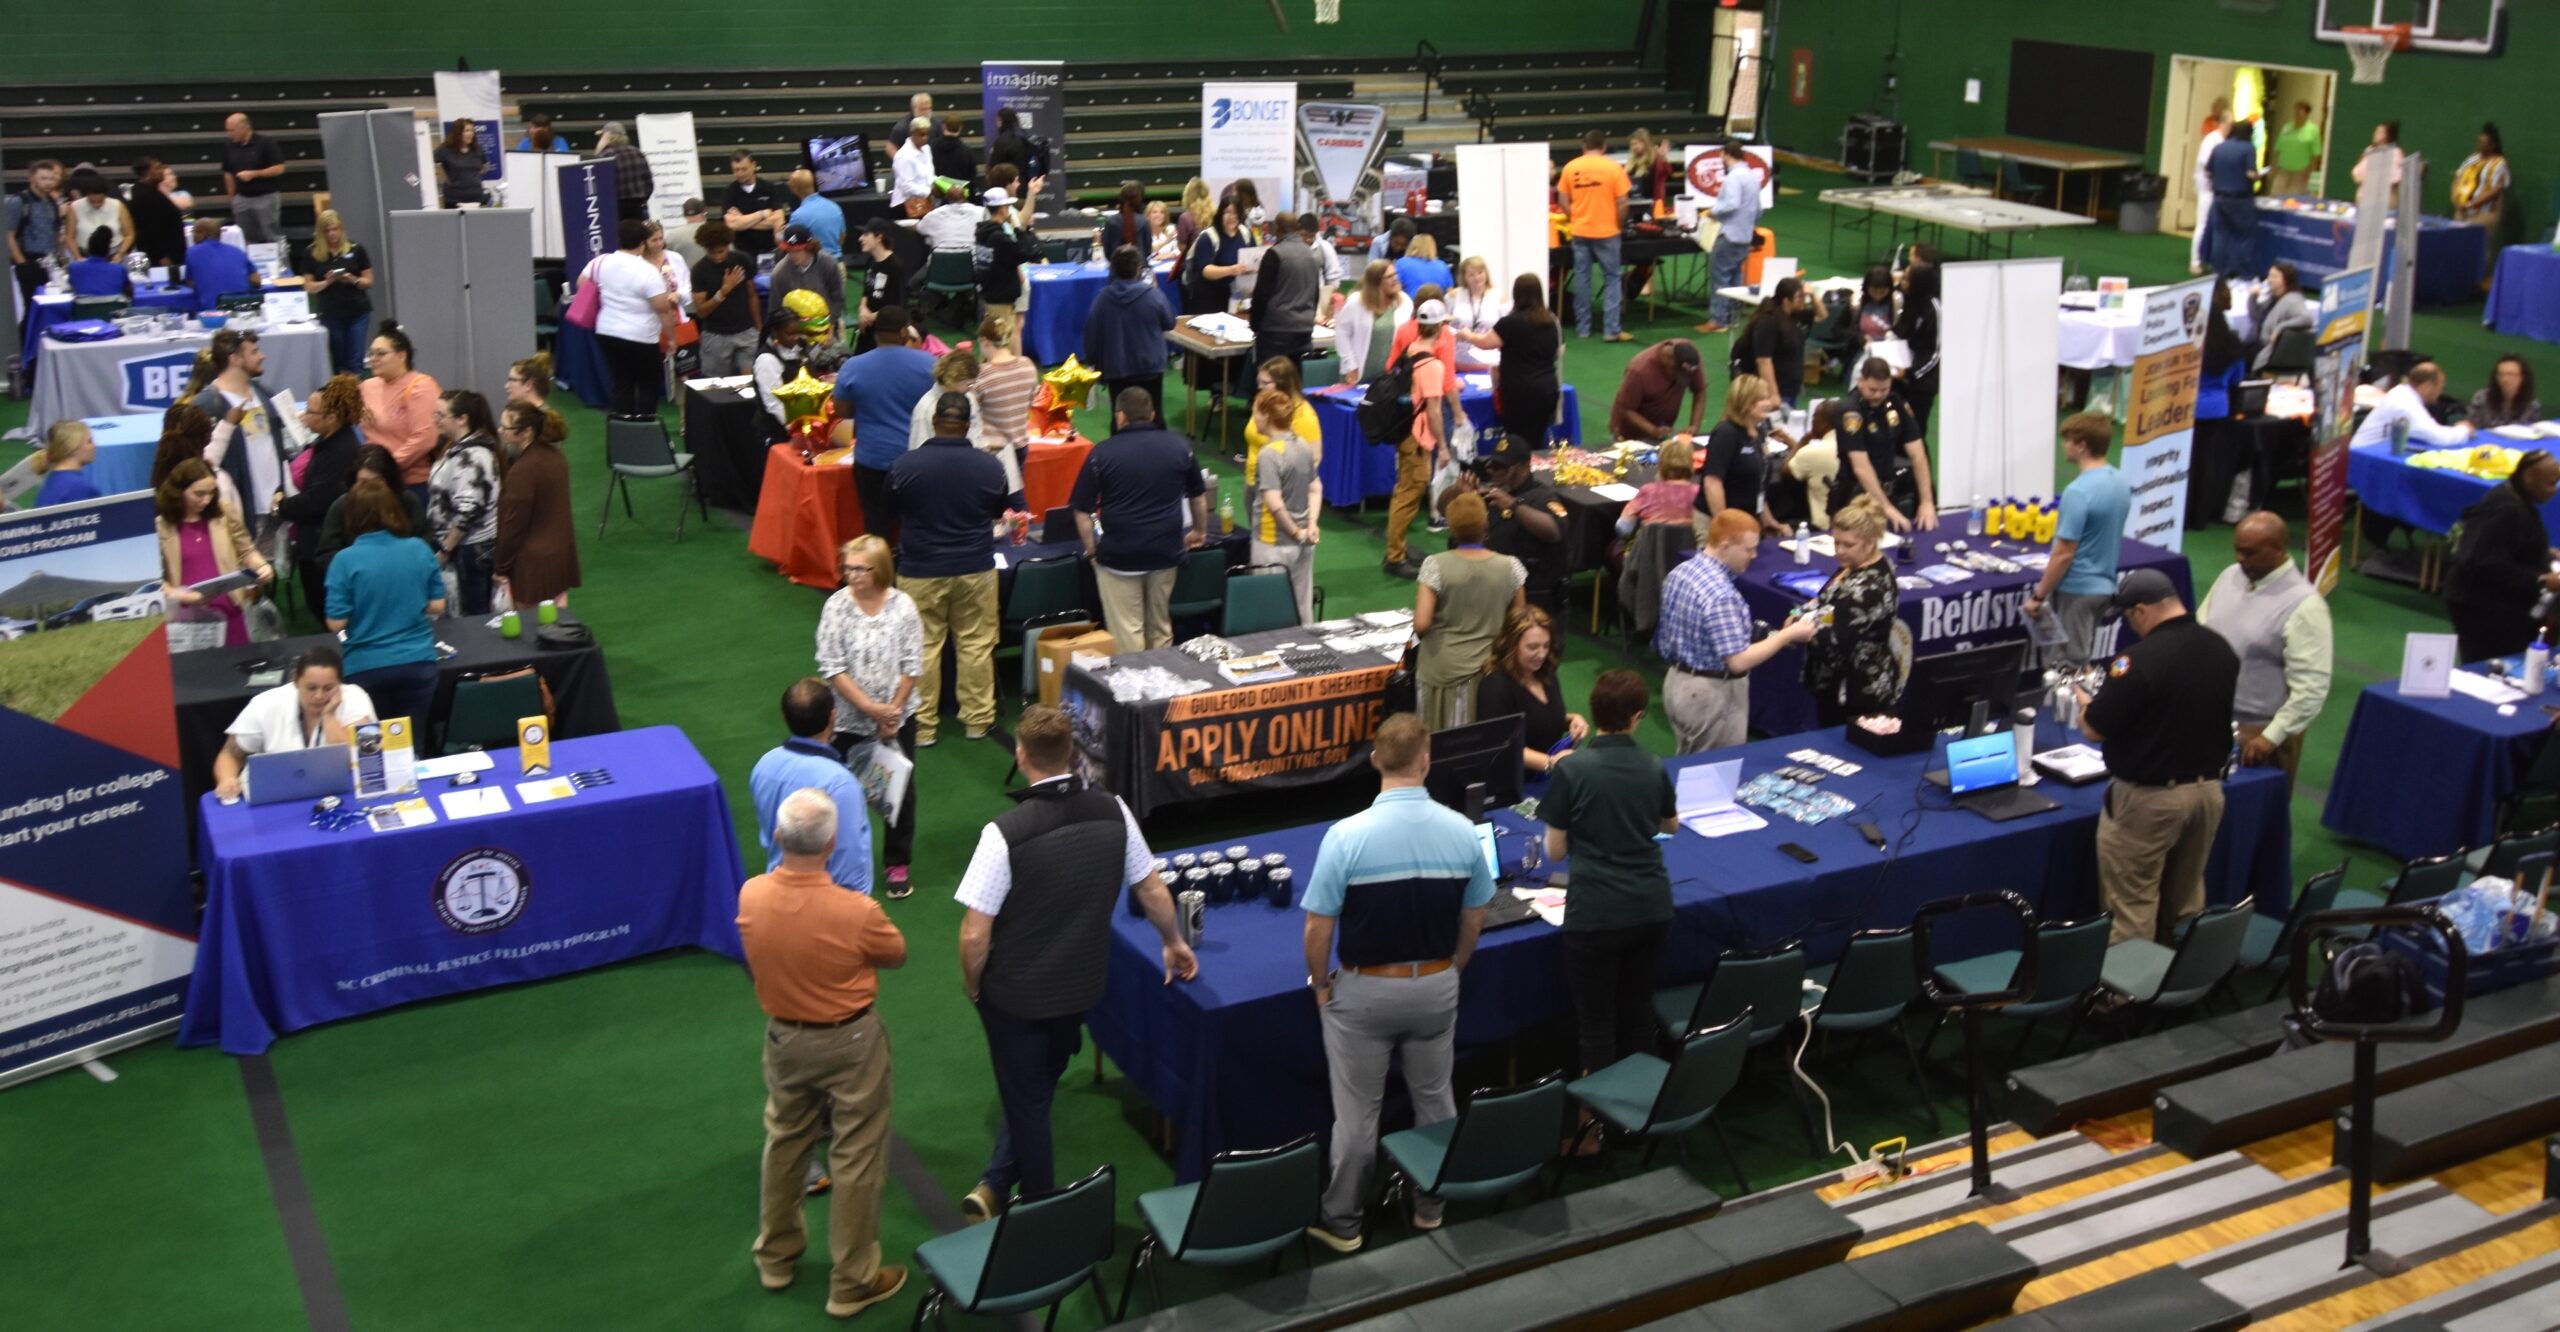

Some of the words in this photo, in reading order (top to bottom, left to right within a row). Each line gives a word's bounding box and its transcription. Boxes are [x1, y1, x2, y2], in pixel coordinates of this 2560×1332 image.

[986, 71, 1059, 91] imagine
[1232, 100, 1289, 121] BONSET
[1317, 138, 1364, 148] CAREERS
[2136, 403, 2193, 436] Leader
[47, 512, 102, 533] JUSTICE
[31, 530, 97, 552] PROGRAM
[1191, 691, 1256, 716] GUILFORD
[1260, 682, 1315, 706] COUNTY
[1319, 671, 1385, 698] SHERIFF'S
[1155, 716, 1262, 774] APPLY
[1266, 698, 1387, 758] ONLINE
[66, 787, 95, 804] for
[95, 768, 170, 797] college.
[32, 816, 78, 844] your
[78, 800, 145, 826] career.
[359, 962, 435, 989] CRIMINAL
[435, 950, 492, 973] JUSTICE
[493, 939, 563, 962] FELLOWS
[562, 923, 631, 950] PROGRAM
